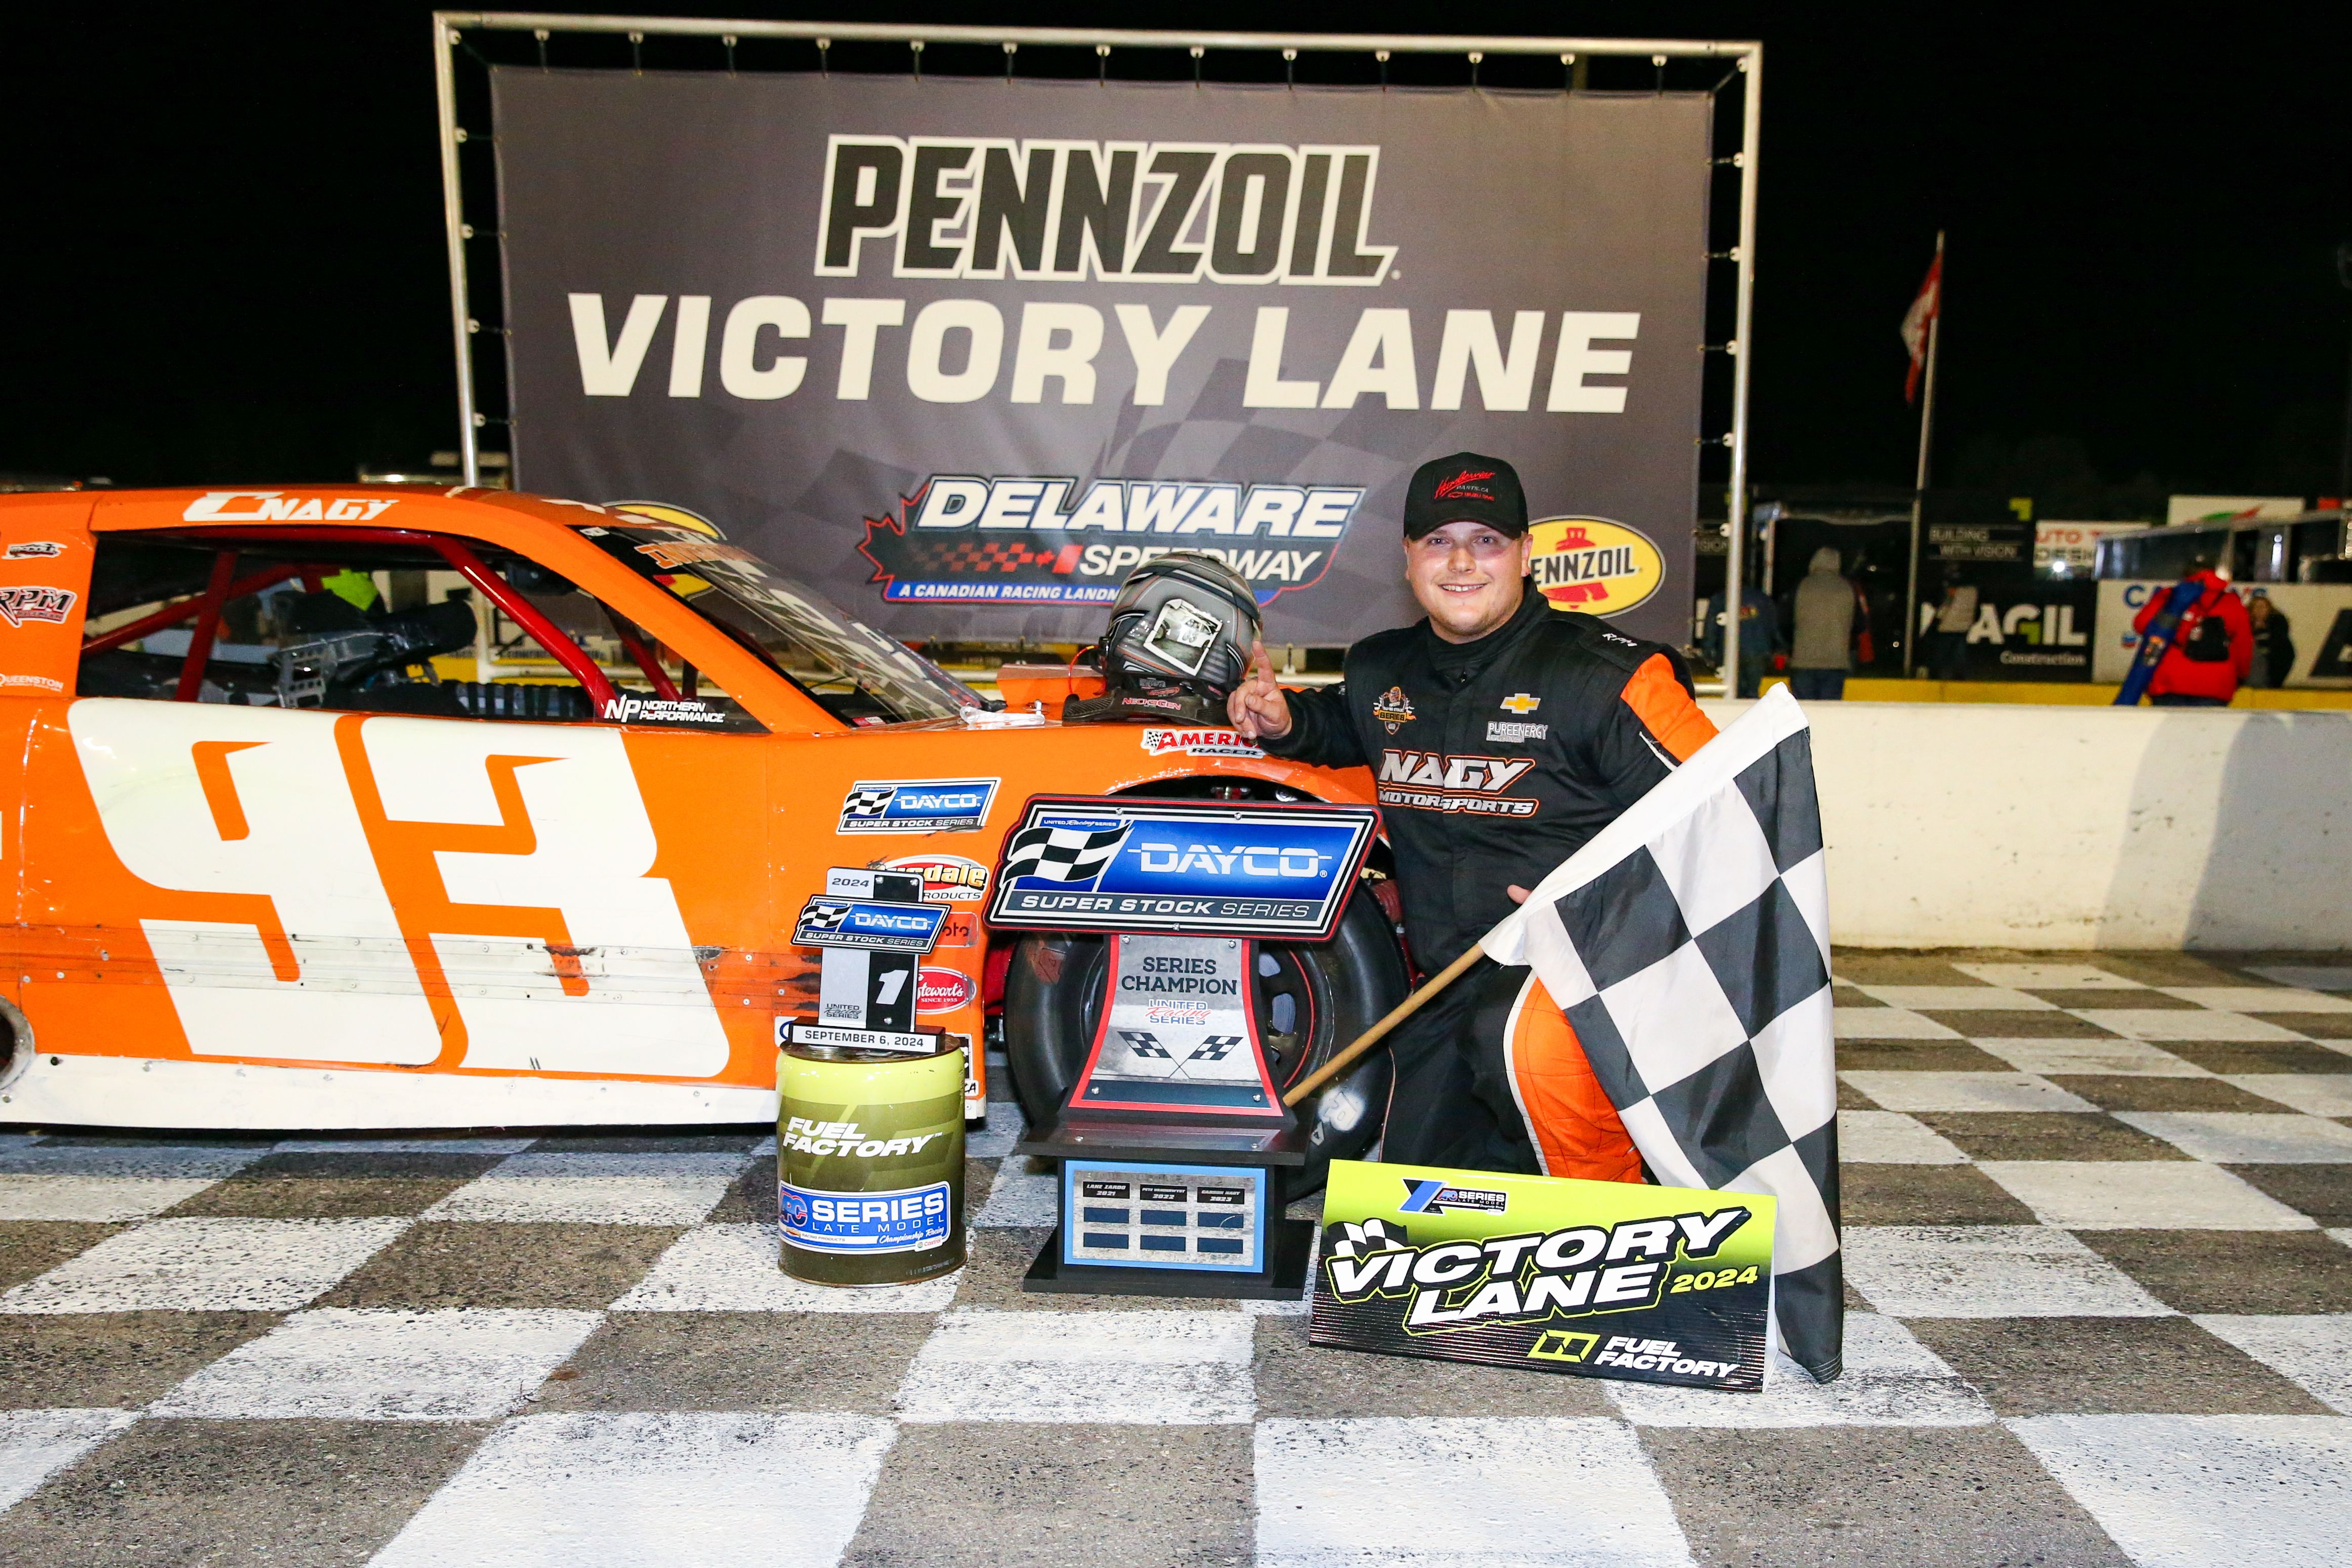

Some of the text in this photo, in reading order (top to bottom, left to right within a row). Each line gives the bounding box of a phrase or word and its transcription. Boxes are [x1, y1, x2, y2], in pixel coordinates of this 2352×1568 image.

[814, 135, 1401, 285] PENNZOIL
[568, 293, 1641, 413] VICTORY LANE
[916, 478, 1366, 538] DELAWARE
[1929, 527, 1989, 542] BUILDING
[2035, 529, 2083, 544] UTO
[1531, 547, 1635, 585] ENNZOIL
[899, 584, 911, 597] A
[914, 584, 998, 598] CANADIAN
[1001, 585, 1061, 599] RACING
[1919, 604, 2087, 646] AGIL
[642, 700, 706, 712] NORTHERN
[1379, 752, 1531, 791] NAGY
[900, 794, 977, 810] DAYCO
[1379, 790, 1534, 814] MOTORSPORTS
[1139, 842, 1321, 878] DAYCO
[66, 698, 729, 1077] 93
[832, 877, 869, 887] 2024
[1020, 895, 1311, 917] SUPER STOCK SERIES
[854, 913, 929, 930] DAYCO
[805, 932, 924, 947] SUPER STOCK SERIES
[1143, 956, 1216, 974] SERIES
[875, 969, 909, 1005] 1
[1121, 975, 1237, 995] CHAMPION
[1146, 1006, 1212, 1021] Racing
[1149, 1000, 1207, 1010] UNITED
[1149, 1015, 1206, 1025] SERIES
[805, 1030, 924, 1047] SEPTEMBER 6, 2024
[787, 1117, 866, 1139] FUEL
[783, 1131, 936, 1158] FACTORY
[1458, 1191, 1505, 1202] SERIES
[812, 1192, 945, 1223] SERIES
[812, 1222, 860, 1233] LATE
[878, 1215, 944, 1233] MODEL
[879, 1231, 924, 1244] Championship
[926, 1226, 945, 1237] Racing
[1333, 1209, 1746, 1294] VICTORY
[1408, 1263, 1758, 1326] LANE 2024
[1605, 1336, 1682, 1357] FUEL
[1593, 1351, 1741, 1378] FACTORY
